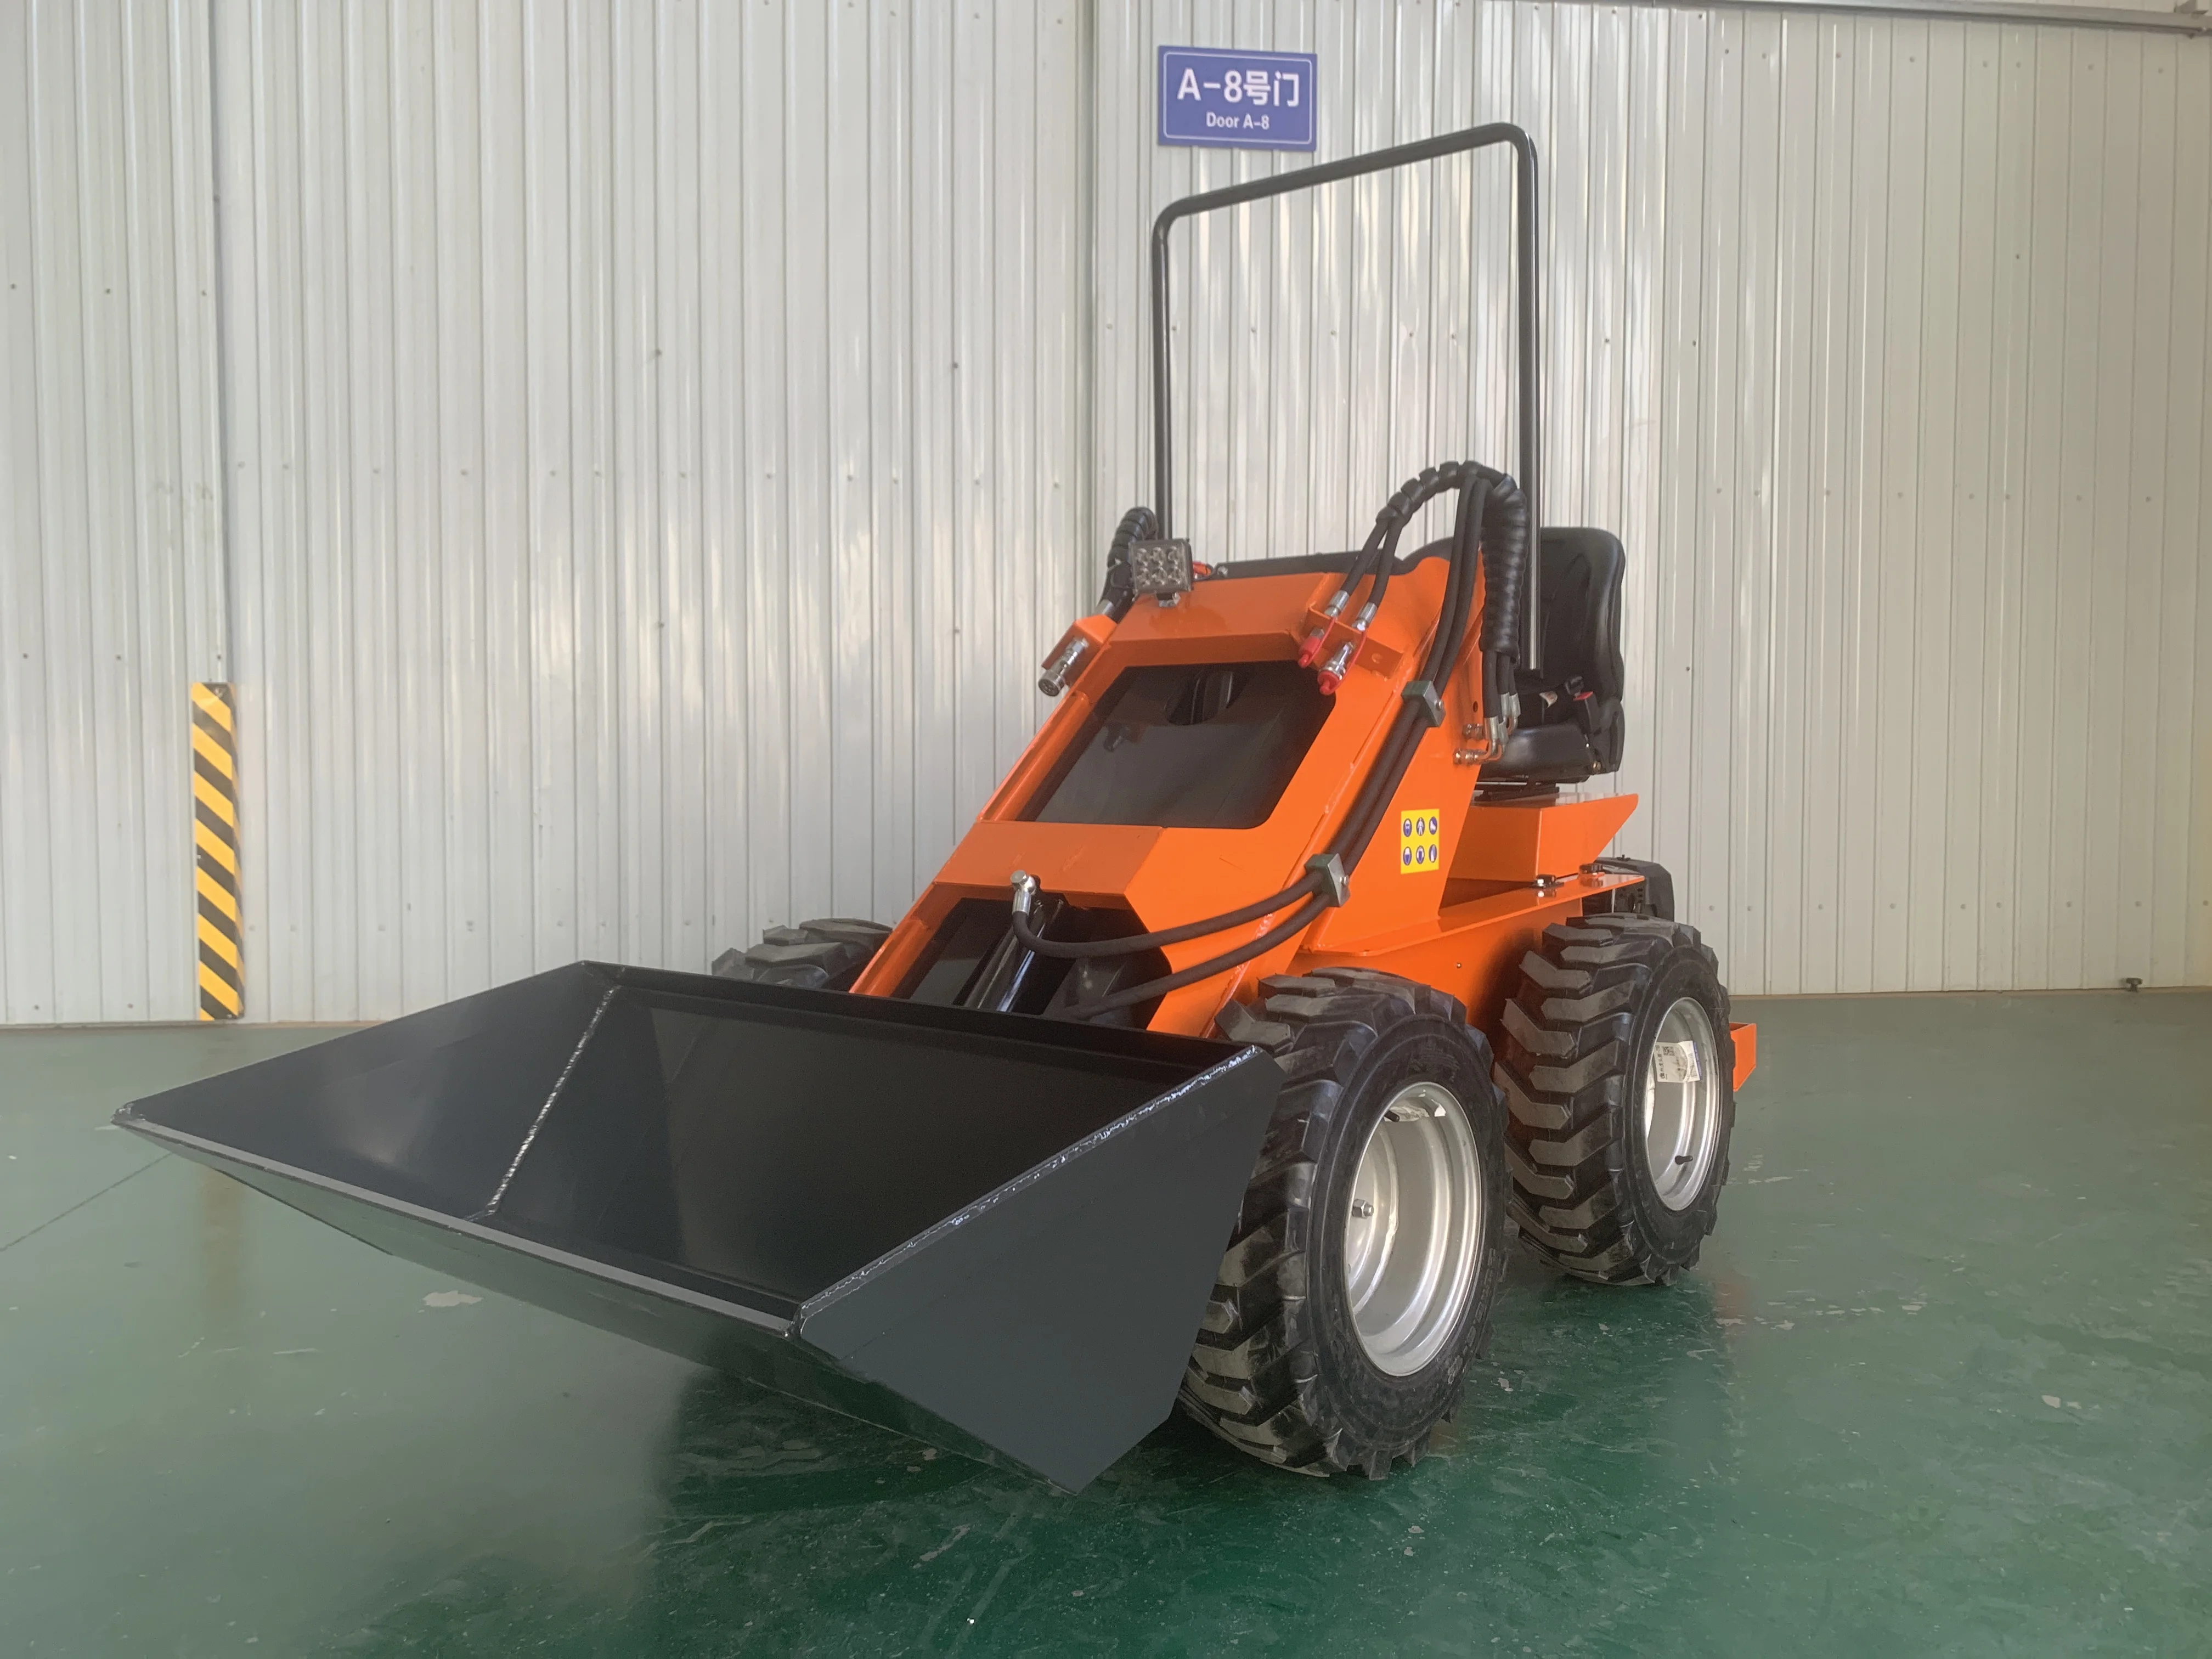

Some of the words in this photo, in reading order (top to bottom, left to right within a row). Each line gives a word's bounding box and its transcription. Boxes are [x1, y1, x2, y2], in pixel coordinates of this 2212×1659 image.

[1177, 67, 1299, 107] A-8号门
[1206, 111, 1239, 128] Door
[1243, 113, 1270, 130] A-8
